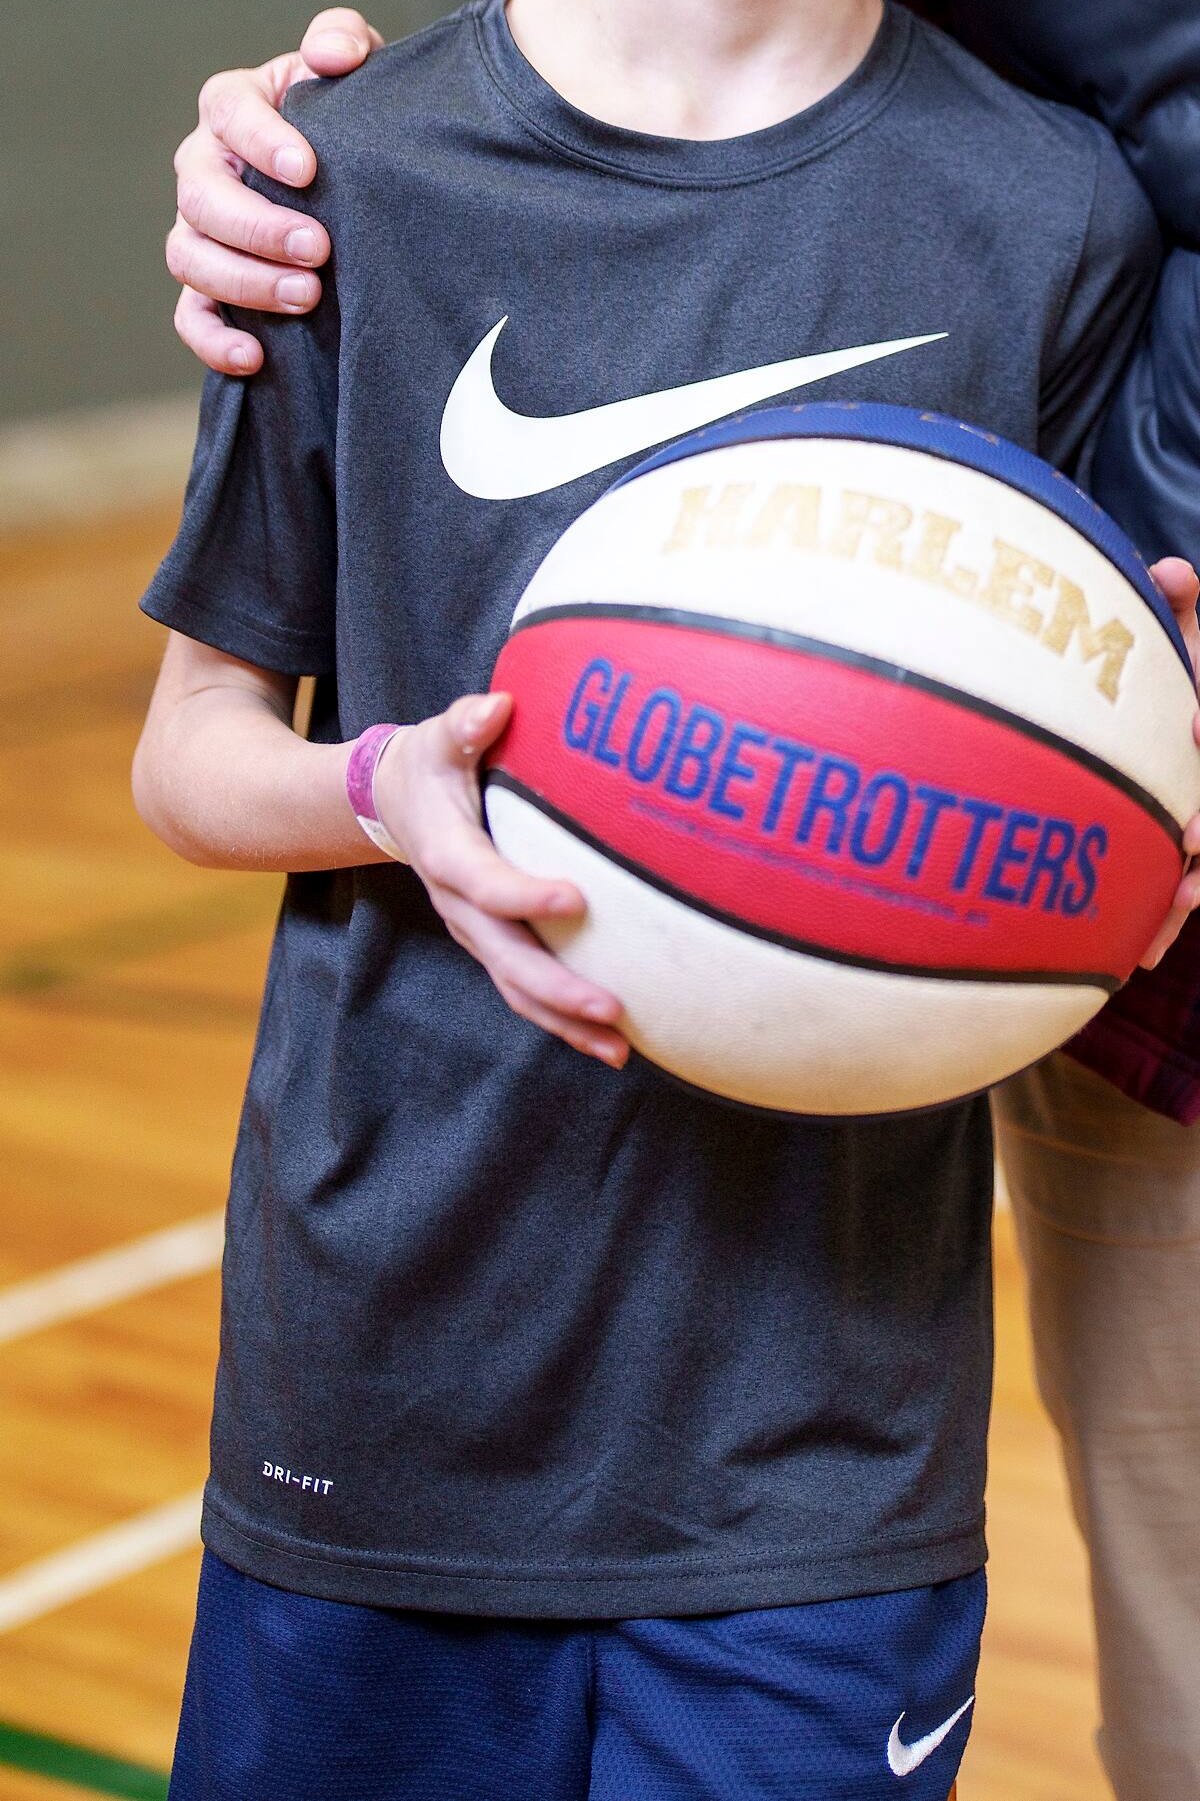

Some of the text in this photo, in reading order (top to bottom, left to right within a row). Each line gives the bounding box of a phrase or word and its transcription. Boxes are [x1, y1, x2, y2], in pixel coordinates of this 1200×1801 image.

[661, 481, 1135, 703] HARLEM
[563, 657, 1108, 917] GLOBETROTTERS
[262, 1461, 334, 1495] DRI-FIT
